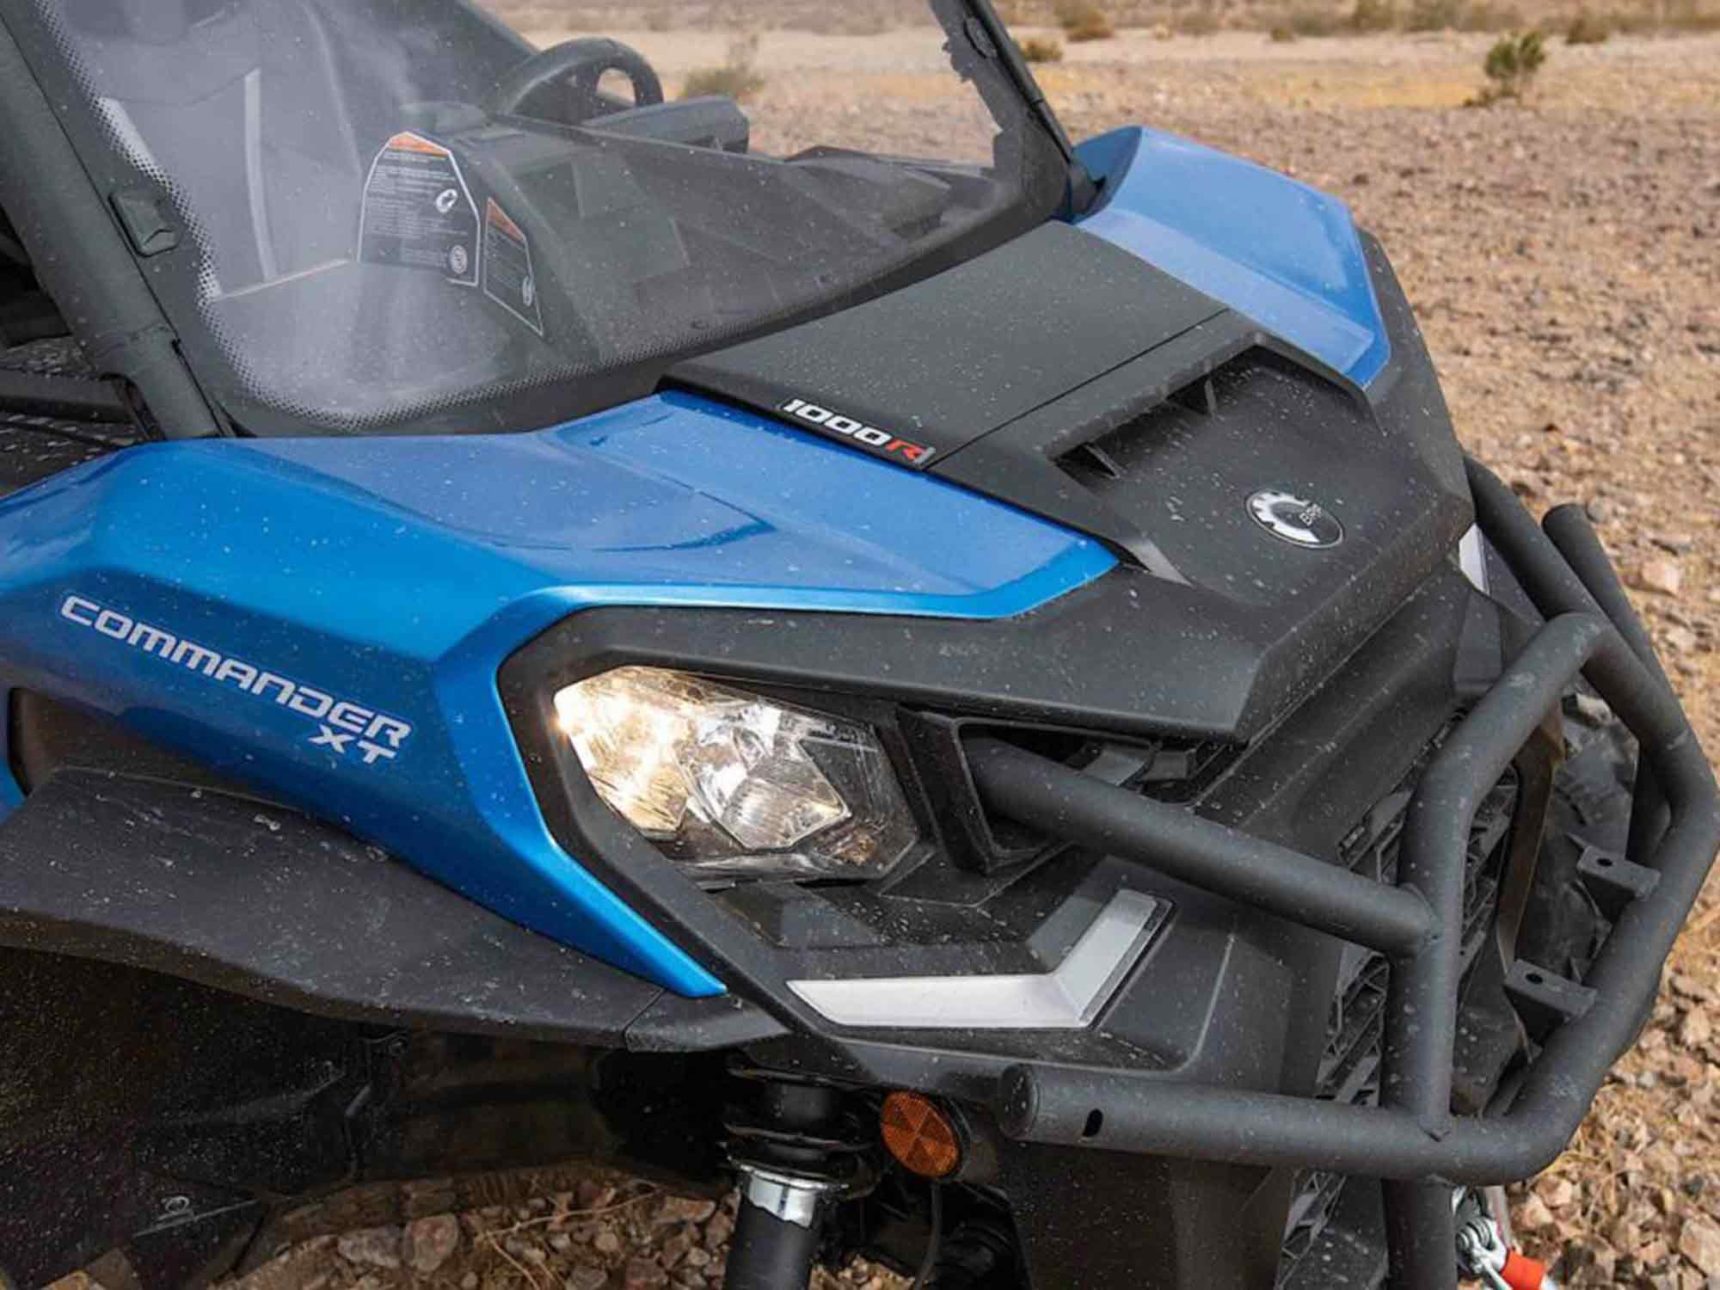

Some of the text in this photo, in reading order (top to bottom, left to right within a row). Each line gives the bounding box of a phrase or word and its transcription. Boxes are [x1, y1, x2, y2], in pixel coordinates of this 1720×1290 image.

[782, 399, 935, 464] 1000R
[60, 595, 412, 748] COMMANDER
[308, 725, 396, 764] XT
